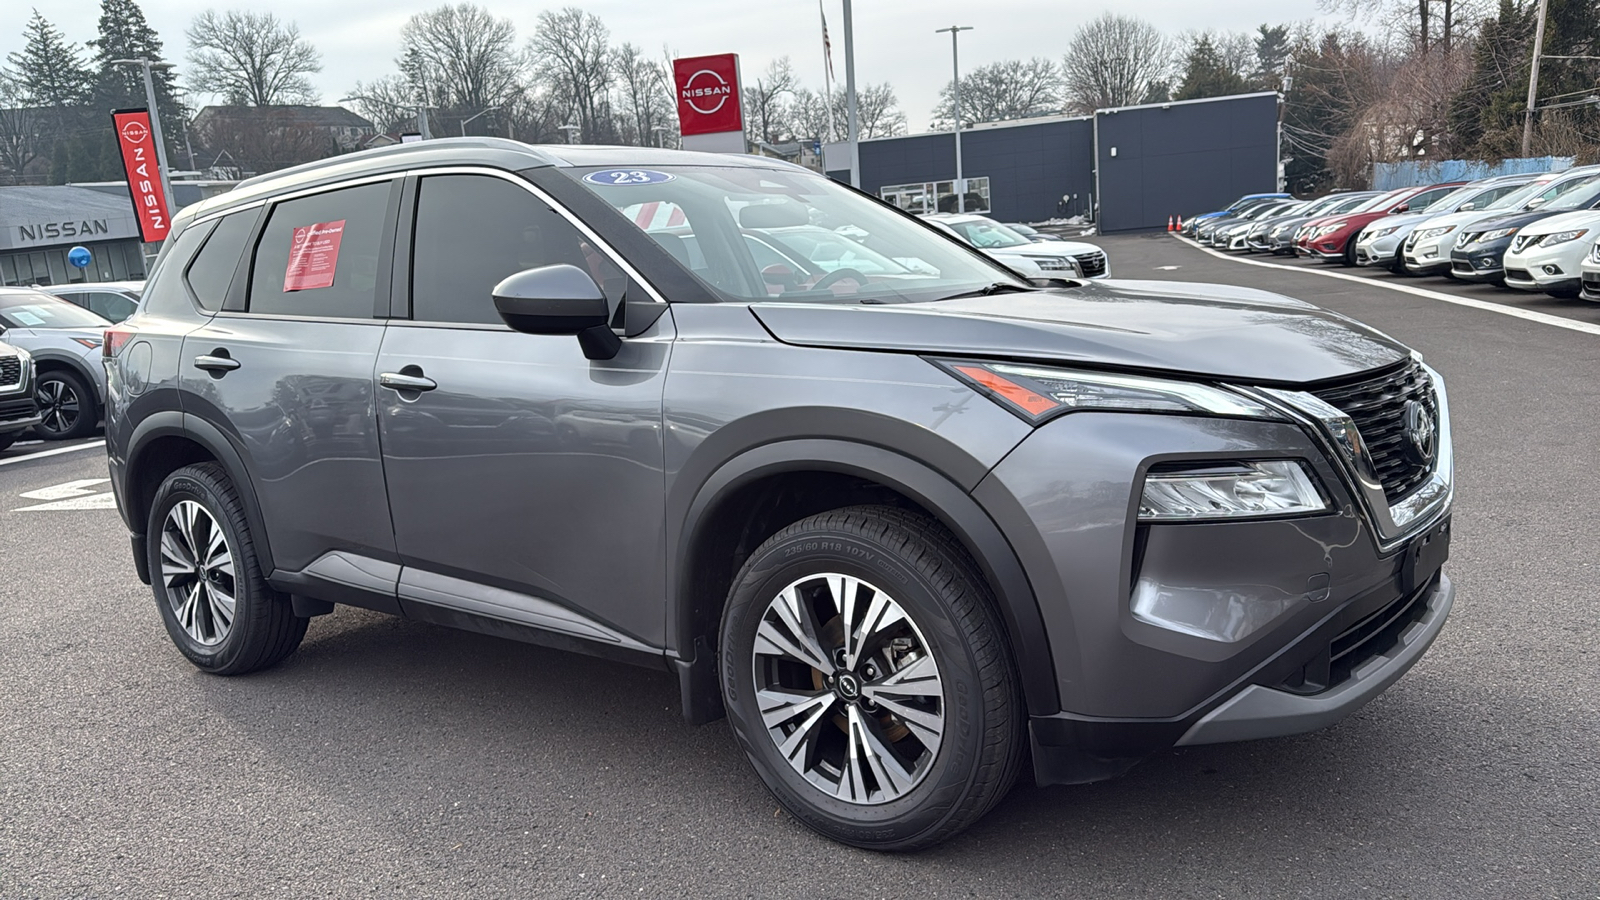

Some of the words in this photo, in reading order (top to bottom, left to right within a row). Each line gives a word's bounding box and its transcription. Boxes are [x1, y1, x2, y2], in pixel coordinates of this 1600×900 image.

[682, 85, 731, 98] NISSAN
[610, 171, 651, 184] 23
[133, 147, 165, 229] NISSAN
[19, 219, 108, 241] NISSAN
[173, 481, 206, 500] GeoDrive
[784, 541, 818, 558] 235/60
[820, 541, 842, 552] R18
[845, 544, 875, 561] 107V
